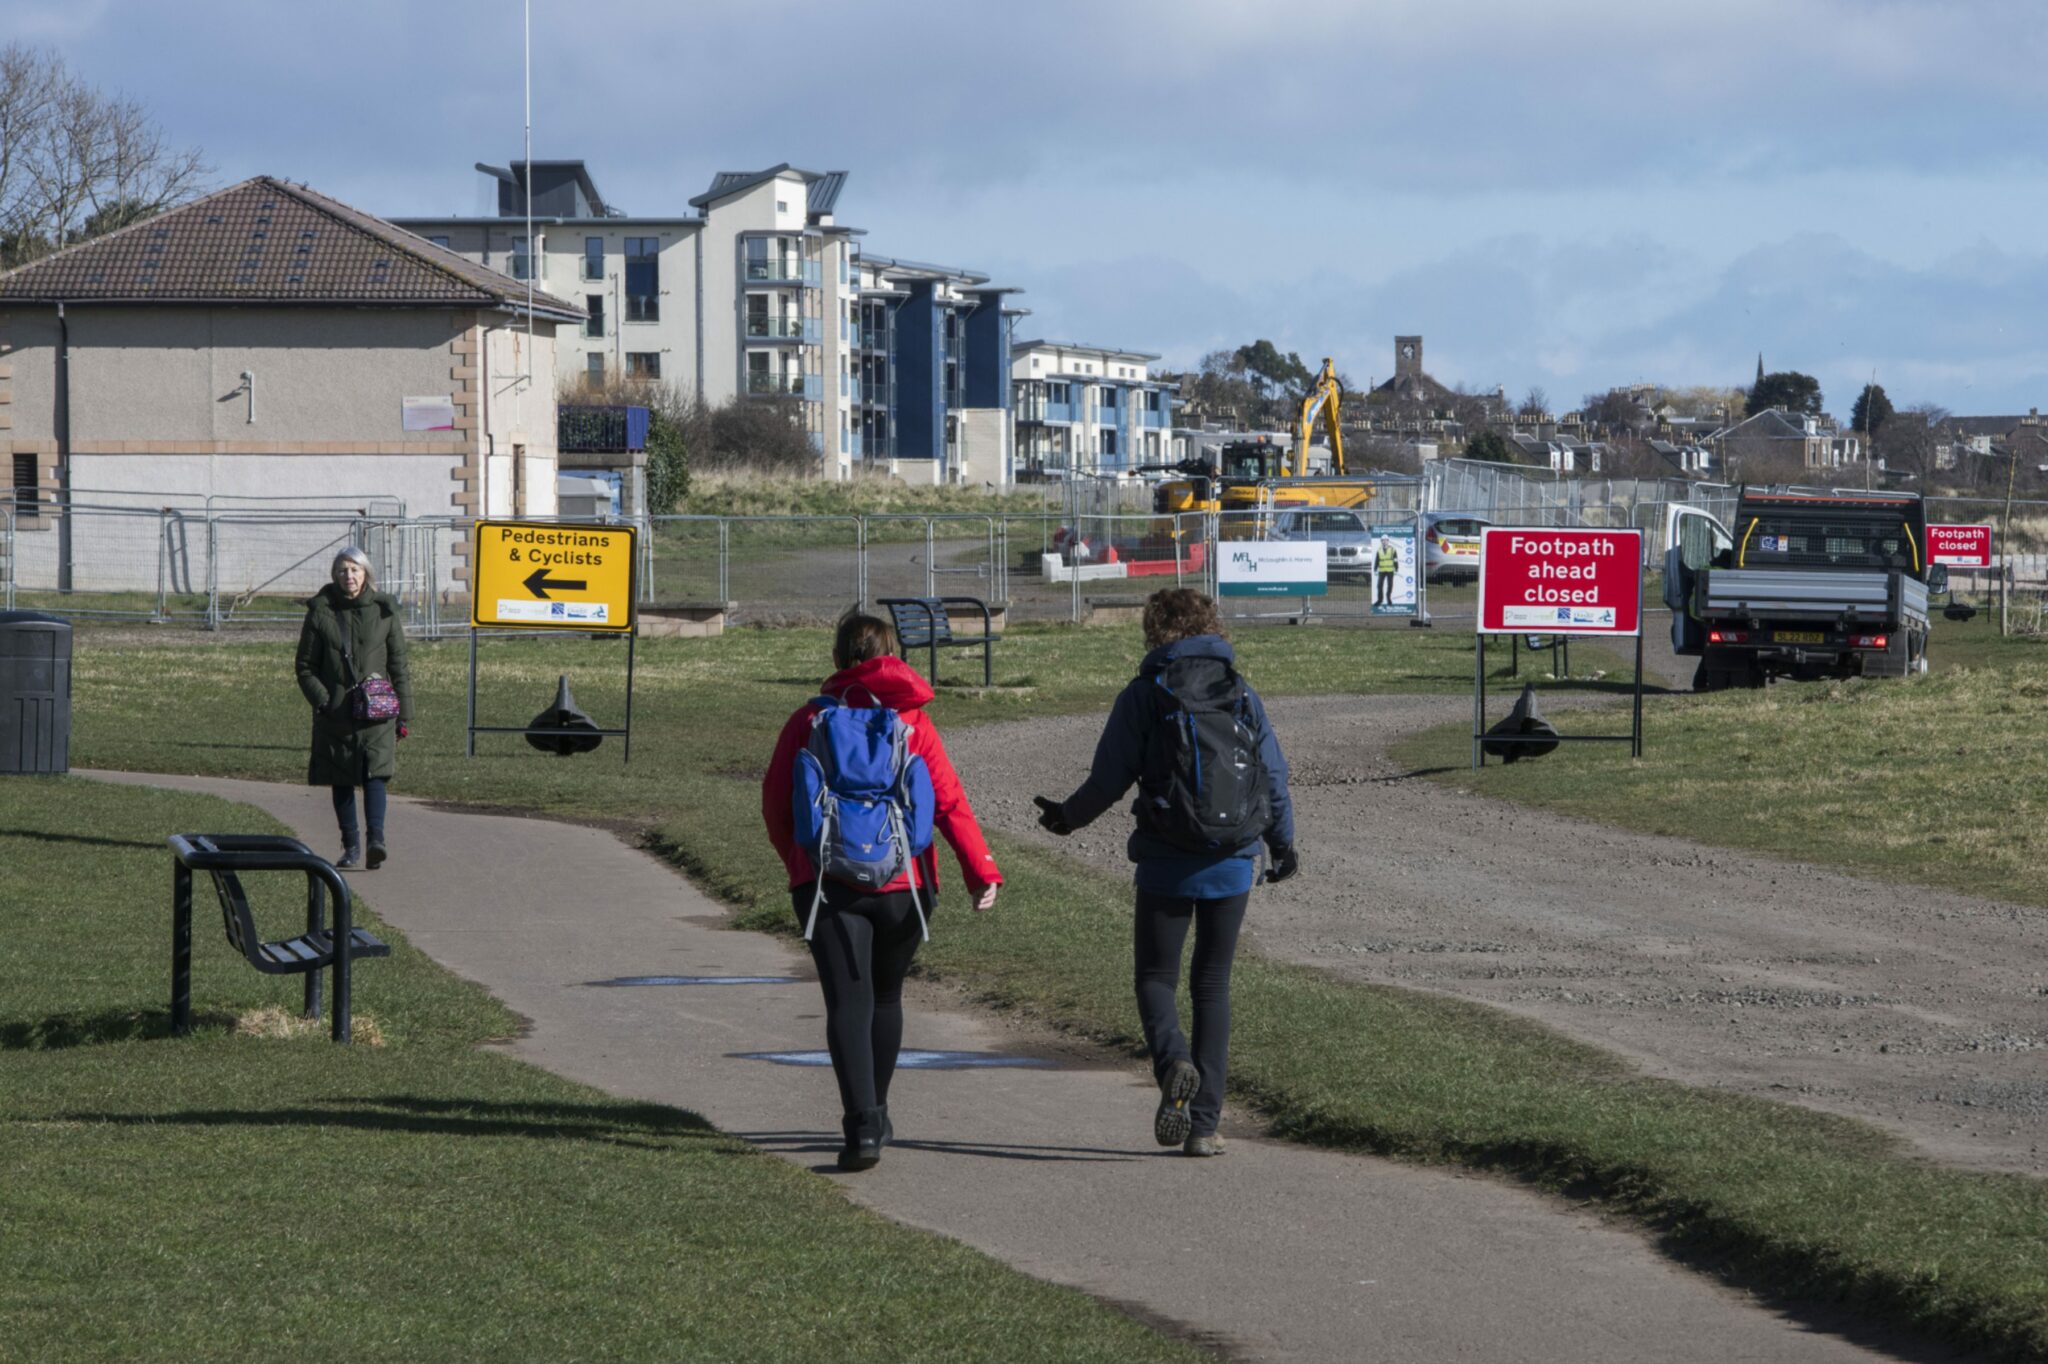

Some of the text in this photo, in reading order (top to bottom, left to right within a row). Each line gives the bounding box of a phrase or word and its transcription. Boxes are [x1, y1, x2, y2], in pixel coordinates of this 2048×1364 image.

[501, 528, 610, 547] Pedestrians
[1931, 528, 1984, 540] Footpath
[1511, 536, 1614, 558] Footpath
[1938, 541, 1977, 550] closed
[509, 548, 602, 566] & Cyclists
[1528, 561, 1596, 579] ahead
[1524, 584, 1599, 603] closed
